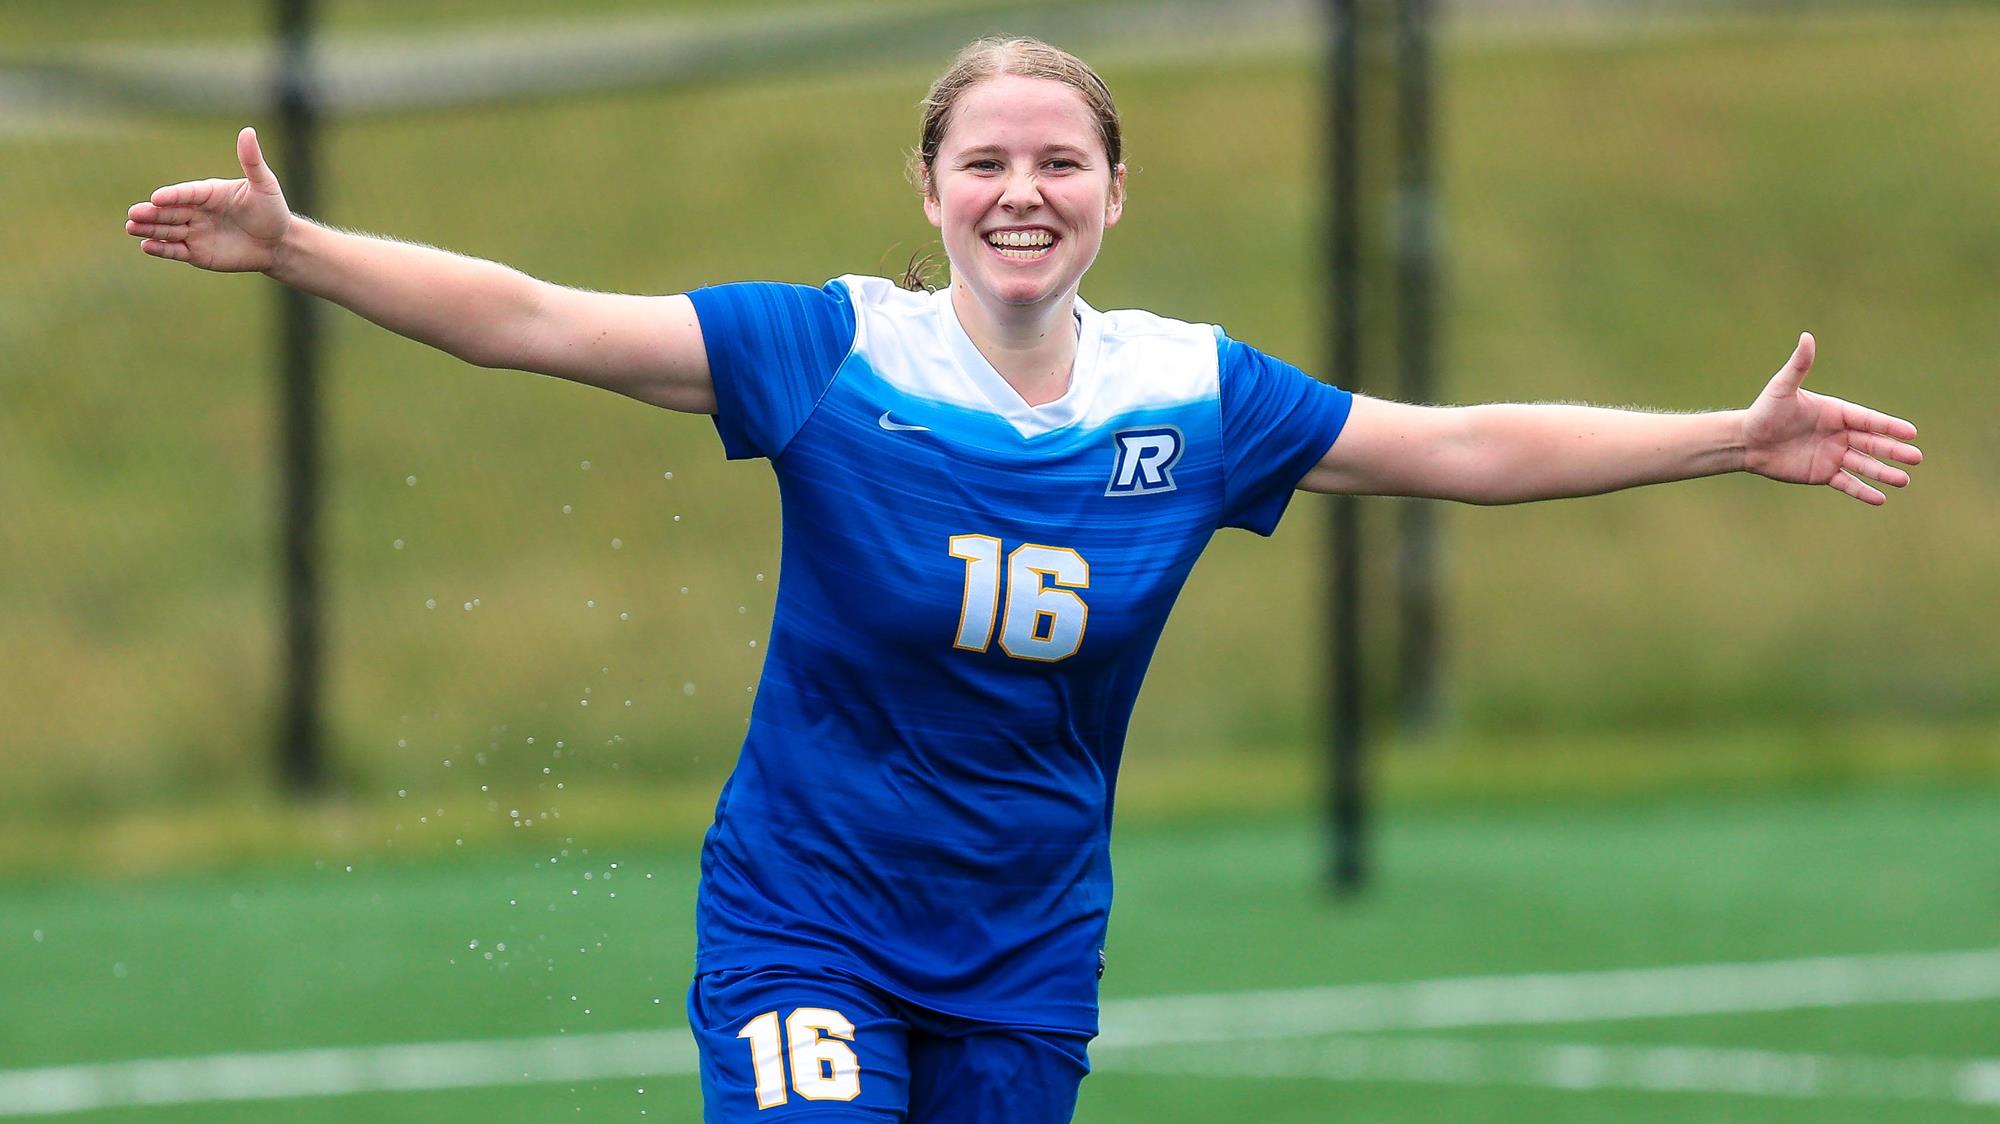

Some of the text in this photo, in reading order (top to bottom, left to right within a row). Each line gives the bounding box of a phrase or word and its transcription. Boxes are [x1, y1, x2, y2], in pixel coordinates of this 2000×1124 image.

[1109, 429, 1180, 492] R
[949, 534, 1090, 662] 16
[737, 1007, 860, 1110] 16
